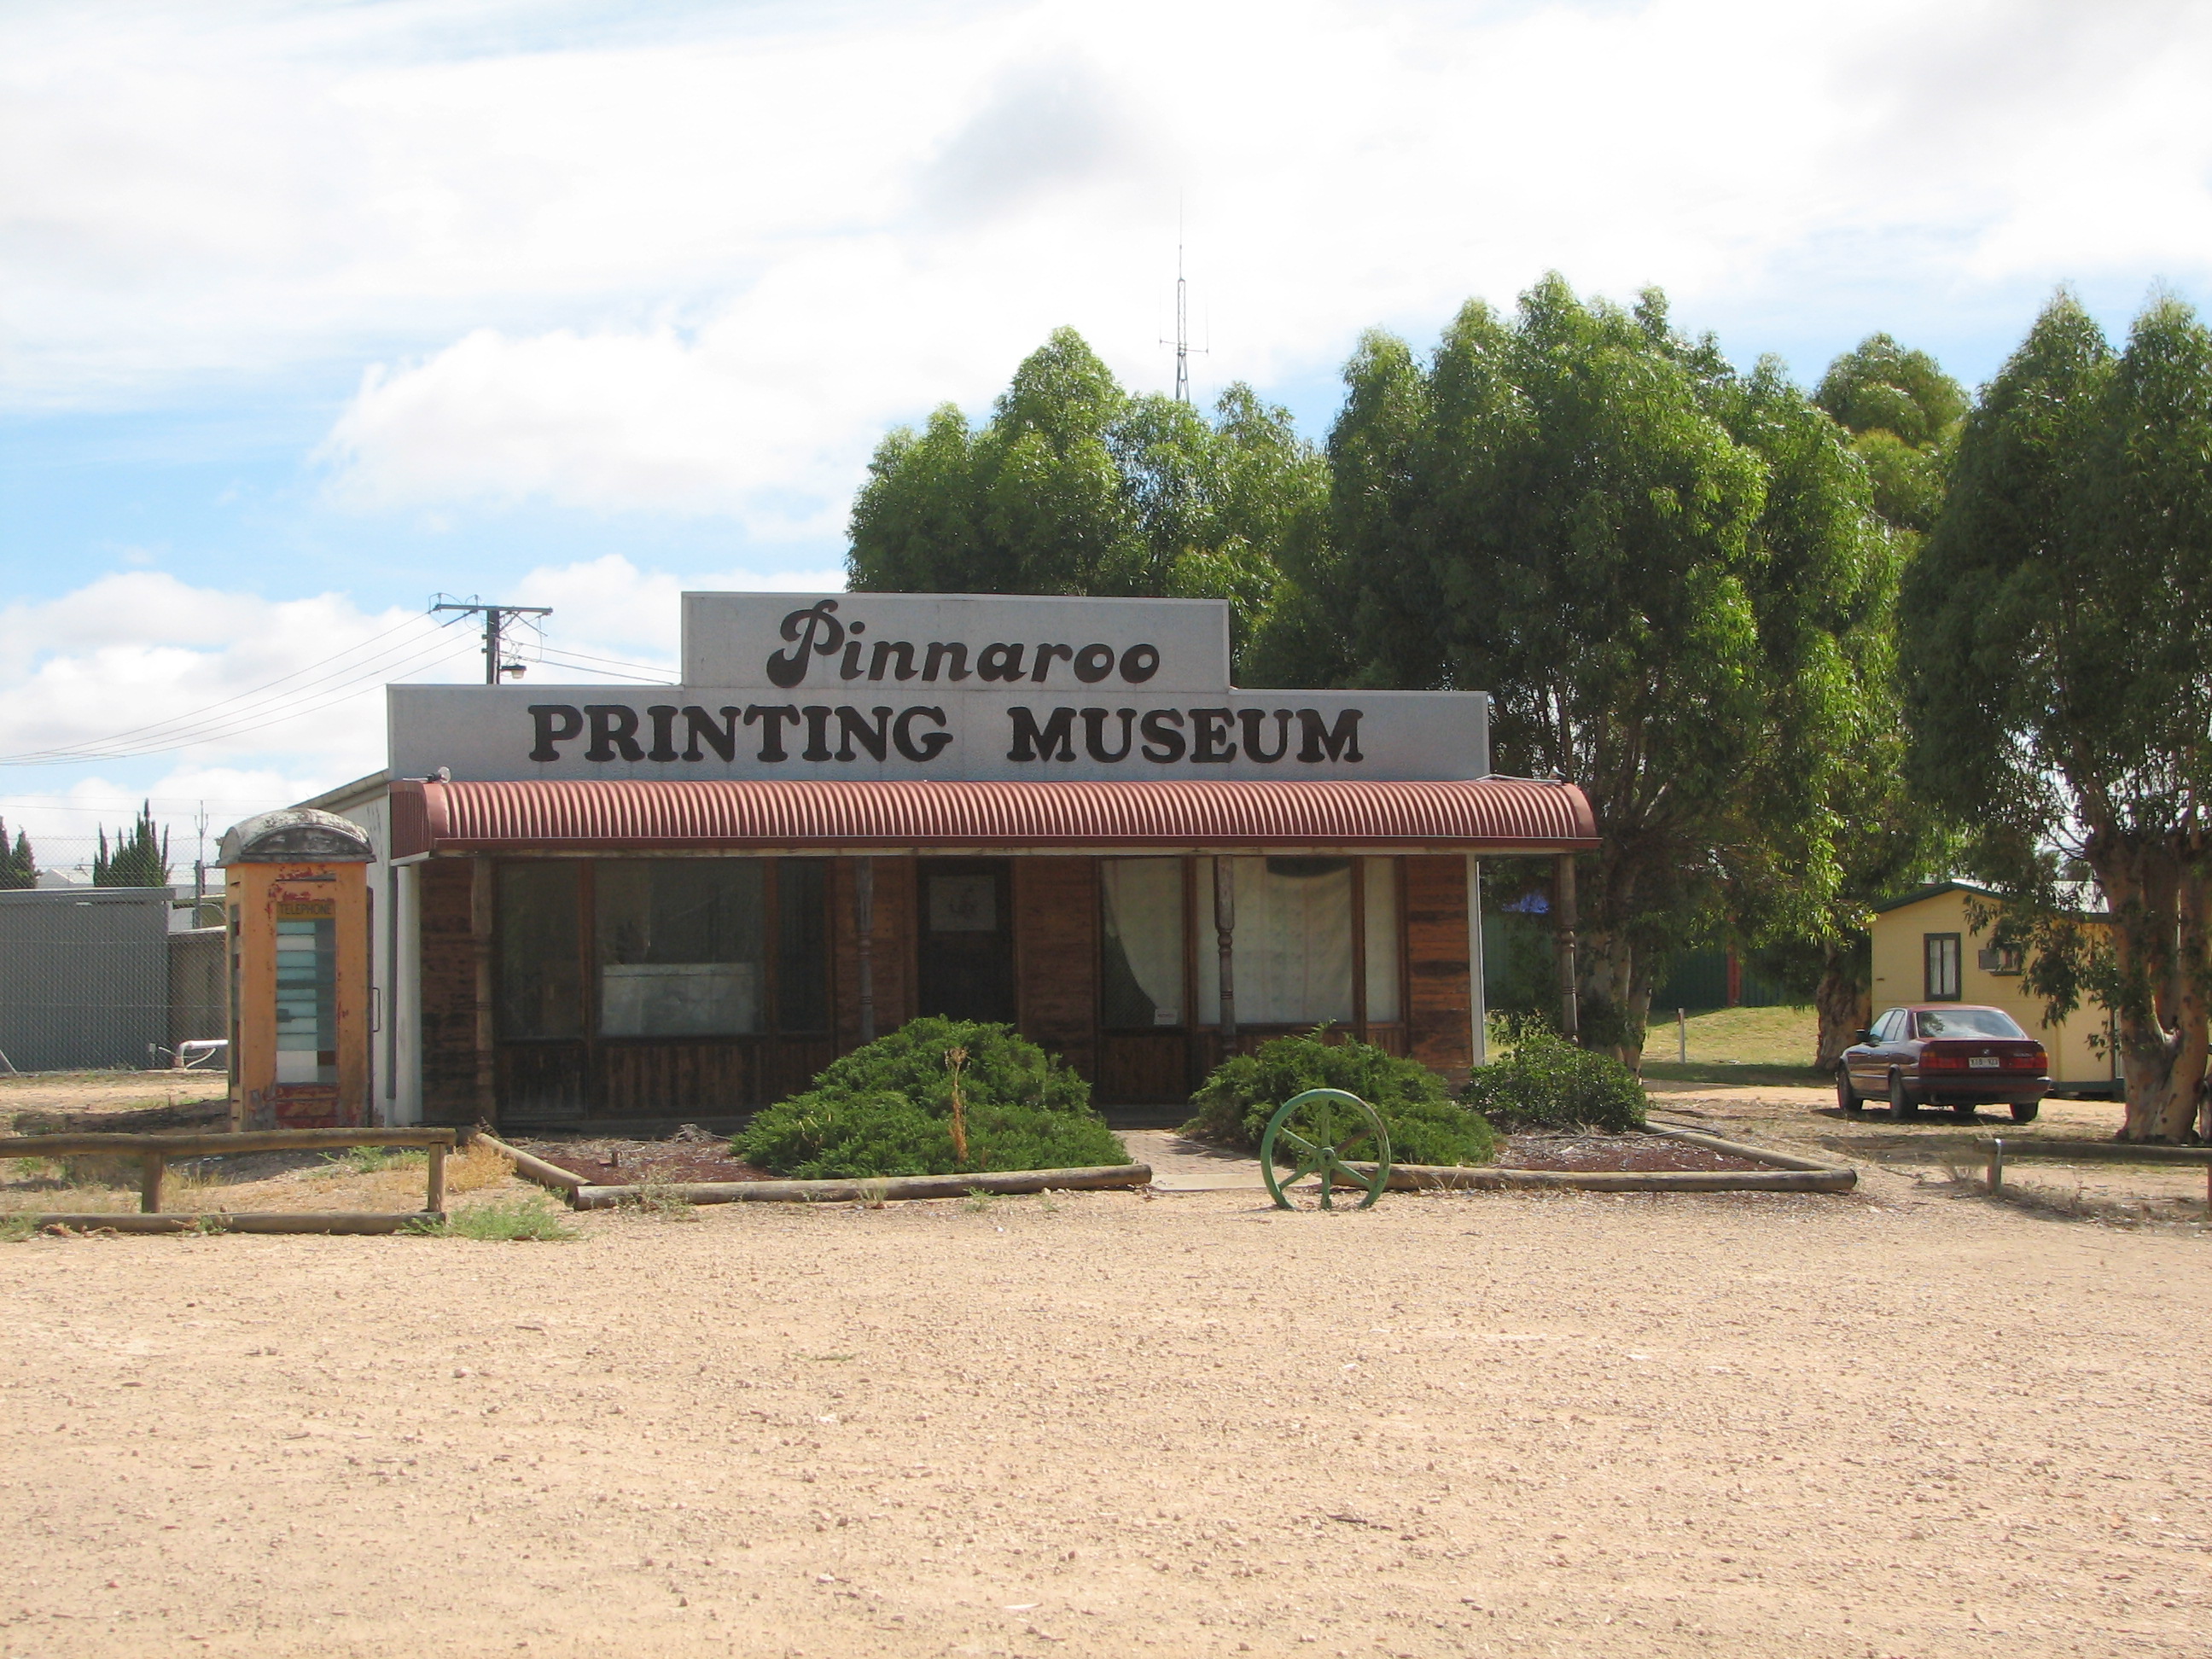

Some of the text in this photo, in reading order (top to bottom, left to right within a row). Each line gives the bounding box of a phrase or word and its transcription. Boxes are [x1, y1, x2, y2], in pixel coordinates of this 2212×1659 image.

[766, 599, 1161, 690] Pinnaroo
[527, 704, 1365, 765] PRINTING MUSEUM
[279, 903, 332, 916] TELEPHONE
